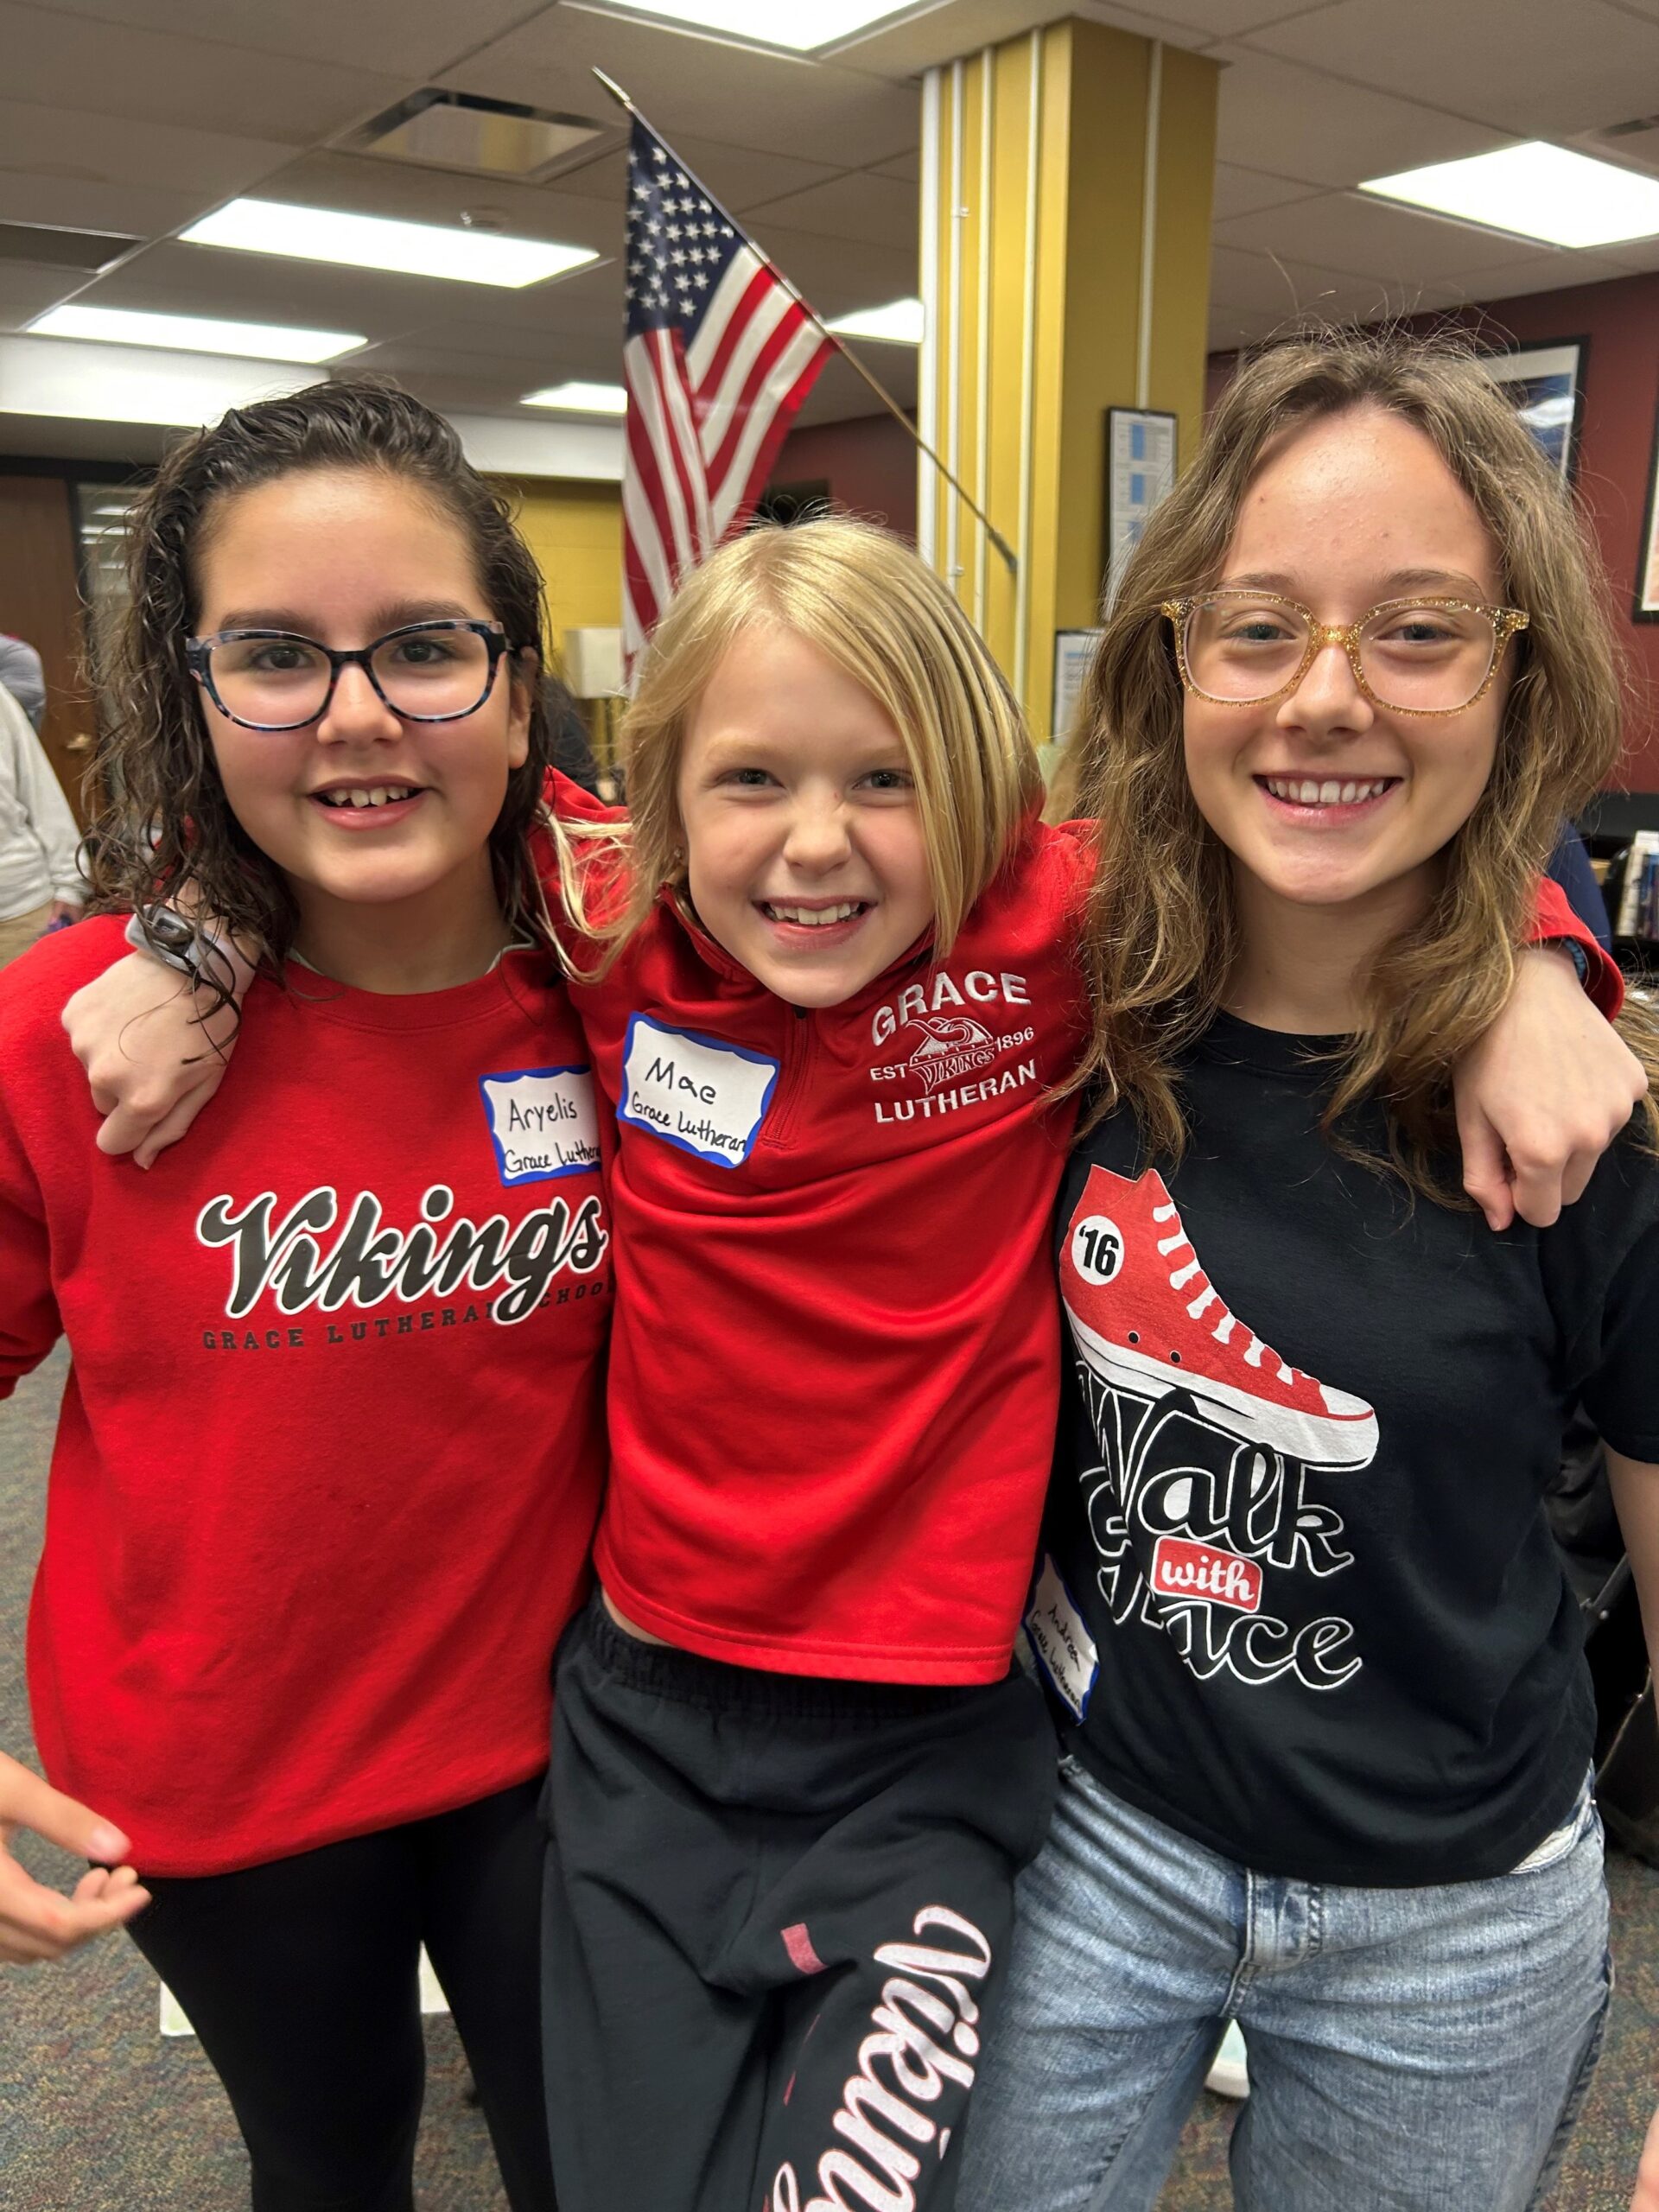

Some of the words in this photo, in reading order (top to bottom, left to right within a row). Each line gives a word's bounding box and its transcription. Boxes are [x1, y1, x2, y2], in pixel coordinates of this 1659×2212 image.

[872, 970, 1032, 1047] GRACE
[645, 1057, 716, 1104] Mae
[870, 1063, 908, 1081] EST
[996, 1027, 1034, 1052] 1896
[909, 1047, 995, 1096] VIKINGS
[508, 1091, 578, 1133] Aryelis
[874, 1058, 1037, 1123] LUTHERAN
[632, 1090, 671, 1127] Grace
[677, 1110, 747, 1153] Lutheran
[504, 1148, 552, 1173] Grace
[195, 1185, 608, 1325] Vikings
[202, 1327, 305, 1350] GRACE
[538, 1281, 615, 1308] CHOO
[1161, 1554, 1255, 1603] with
